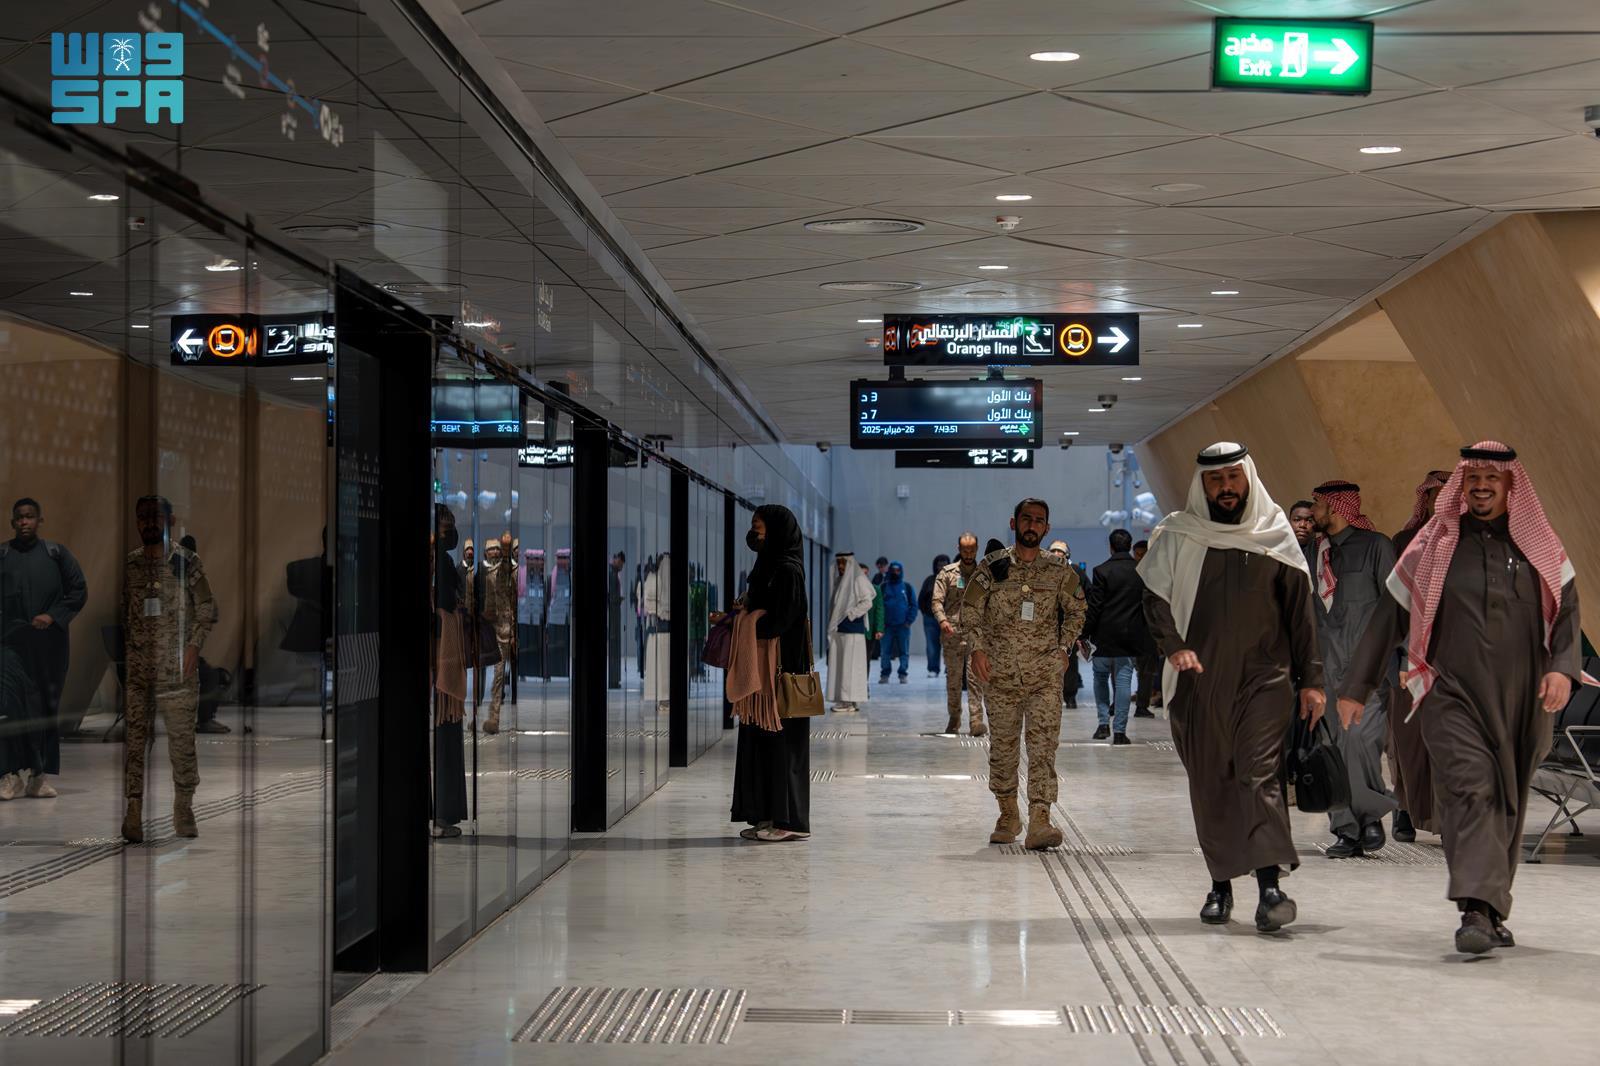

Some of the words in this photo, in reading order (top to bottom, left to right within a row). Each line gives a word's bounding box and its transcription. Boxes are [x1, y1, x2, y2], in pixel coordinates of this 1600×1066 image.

[1225, 33, 1274, 56] مخرج
[1239, 58, 1272, 77] Exit
[918, 324, 973, 345] البرتقالي
[977, 324, 1018, 341] المسار
[946, 341, 991, 357] Orange
[994, 341, 1018, 355] line
[987, 391, 1011, 404] الأول
[1014, 391, 1032, 404] بنك
[871, 410, 877, 420] 7
[987, 409, 1011, 421] الأول
[1014, 409, 1032, 421] بنك
[974, 457, 989, 465] Exit
